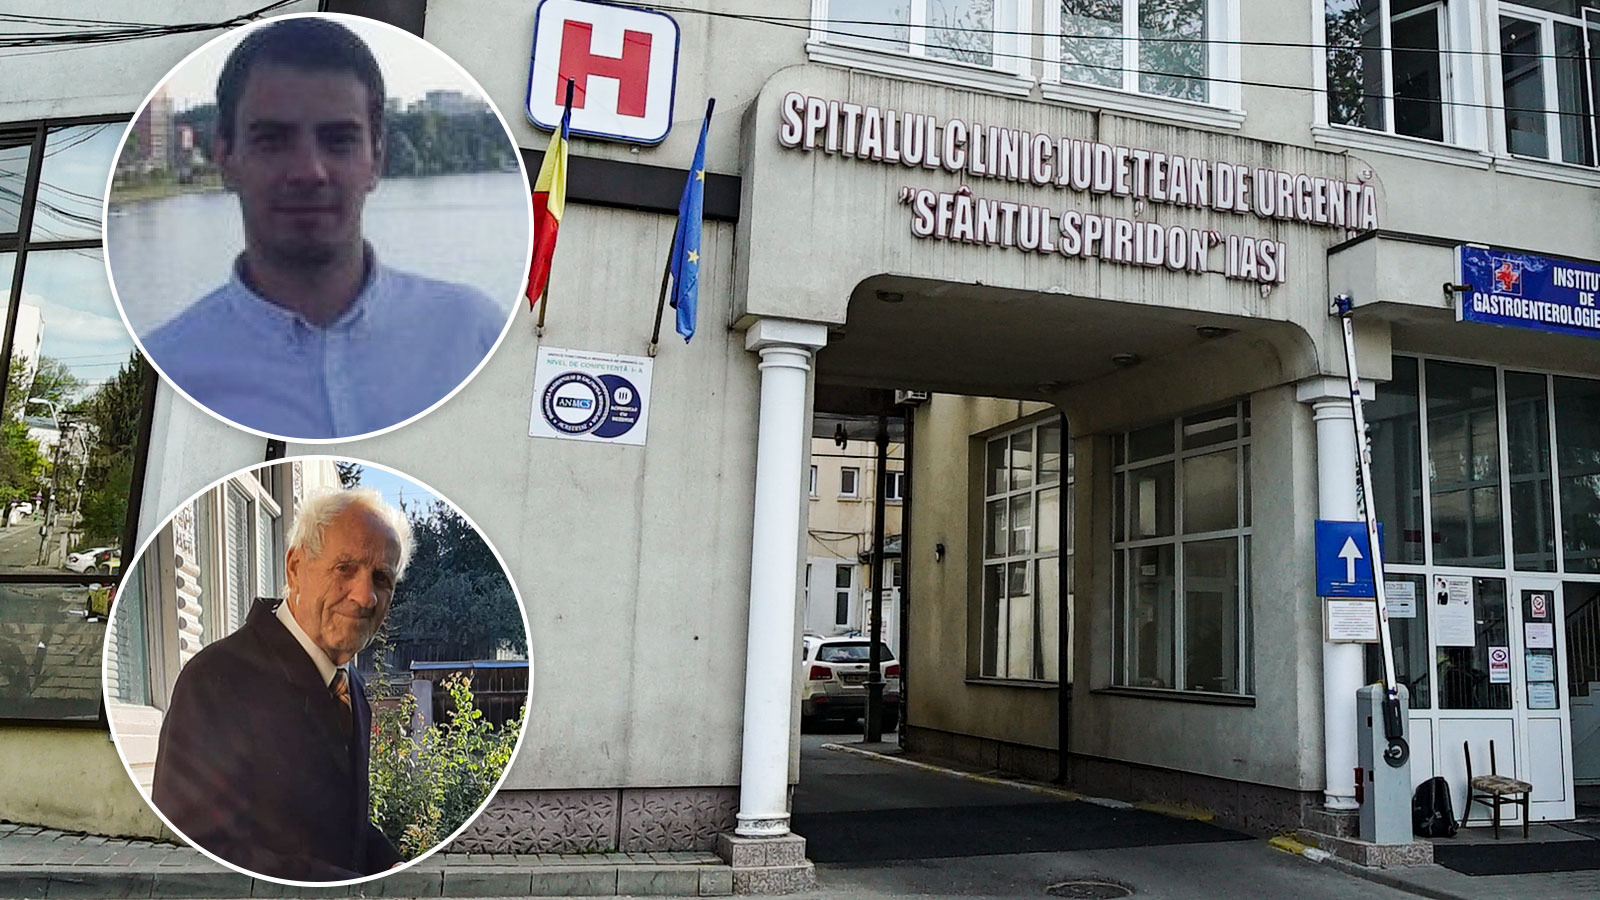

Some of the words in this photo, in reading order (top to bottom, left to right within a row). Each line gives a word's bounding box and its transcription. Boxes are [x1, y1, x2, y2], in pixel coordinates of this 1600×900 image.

[555, 19, 653, 119] H
[779, 92, 941, 169] SPITALUL
[942, 118, 1053, 186] CLINIC
[1055, 137, 1209, 215] JUDEȚEAN
[1212, 161, 1250, 215] DE
[1253, 168, 1379, 241] URGENȚĂ
[1225, 234, 1287, 298] IAȘI
[1553, 266, 1600, 291] INSTITU
[1473, 292, 1600, 329] GASTROENTEROLOGIE
[1579, 291, 1595, 306] DE
[546, 359, 568, 367] NIVEL
[558, 398, 591, 408] ANMCS
